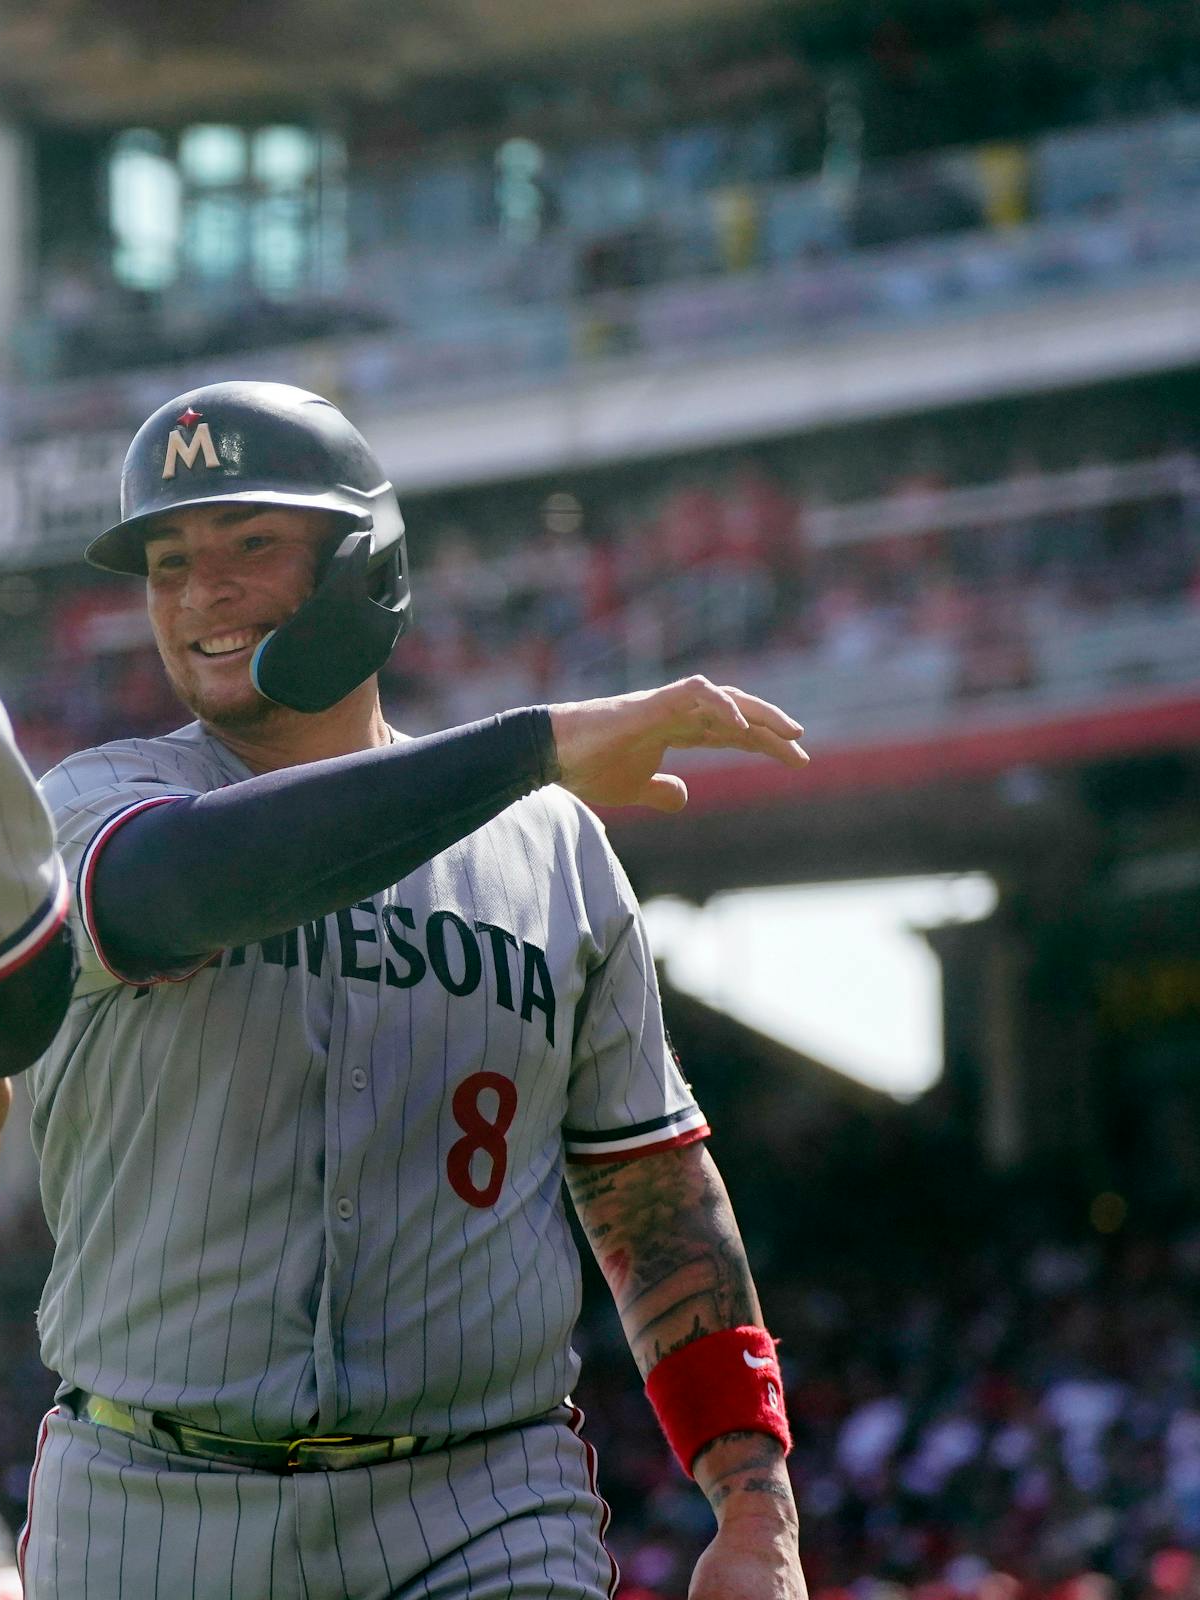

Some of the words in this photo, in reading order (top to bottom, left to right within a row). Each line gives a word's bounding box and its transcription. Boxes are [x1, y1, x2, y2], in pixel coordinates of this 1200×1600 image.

[163, 423, 220, 479] M
[446, 1071, 518, 1208] 8
[768, 1383, 778, 1409] 8
